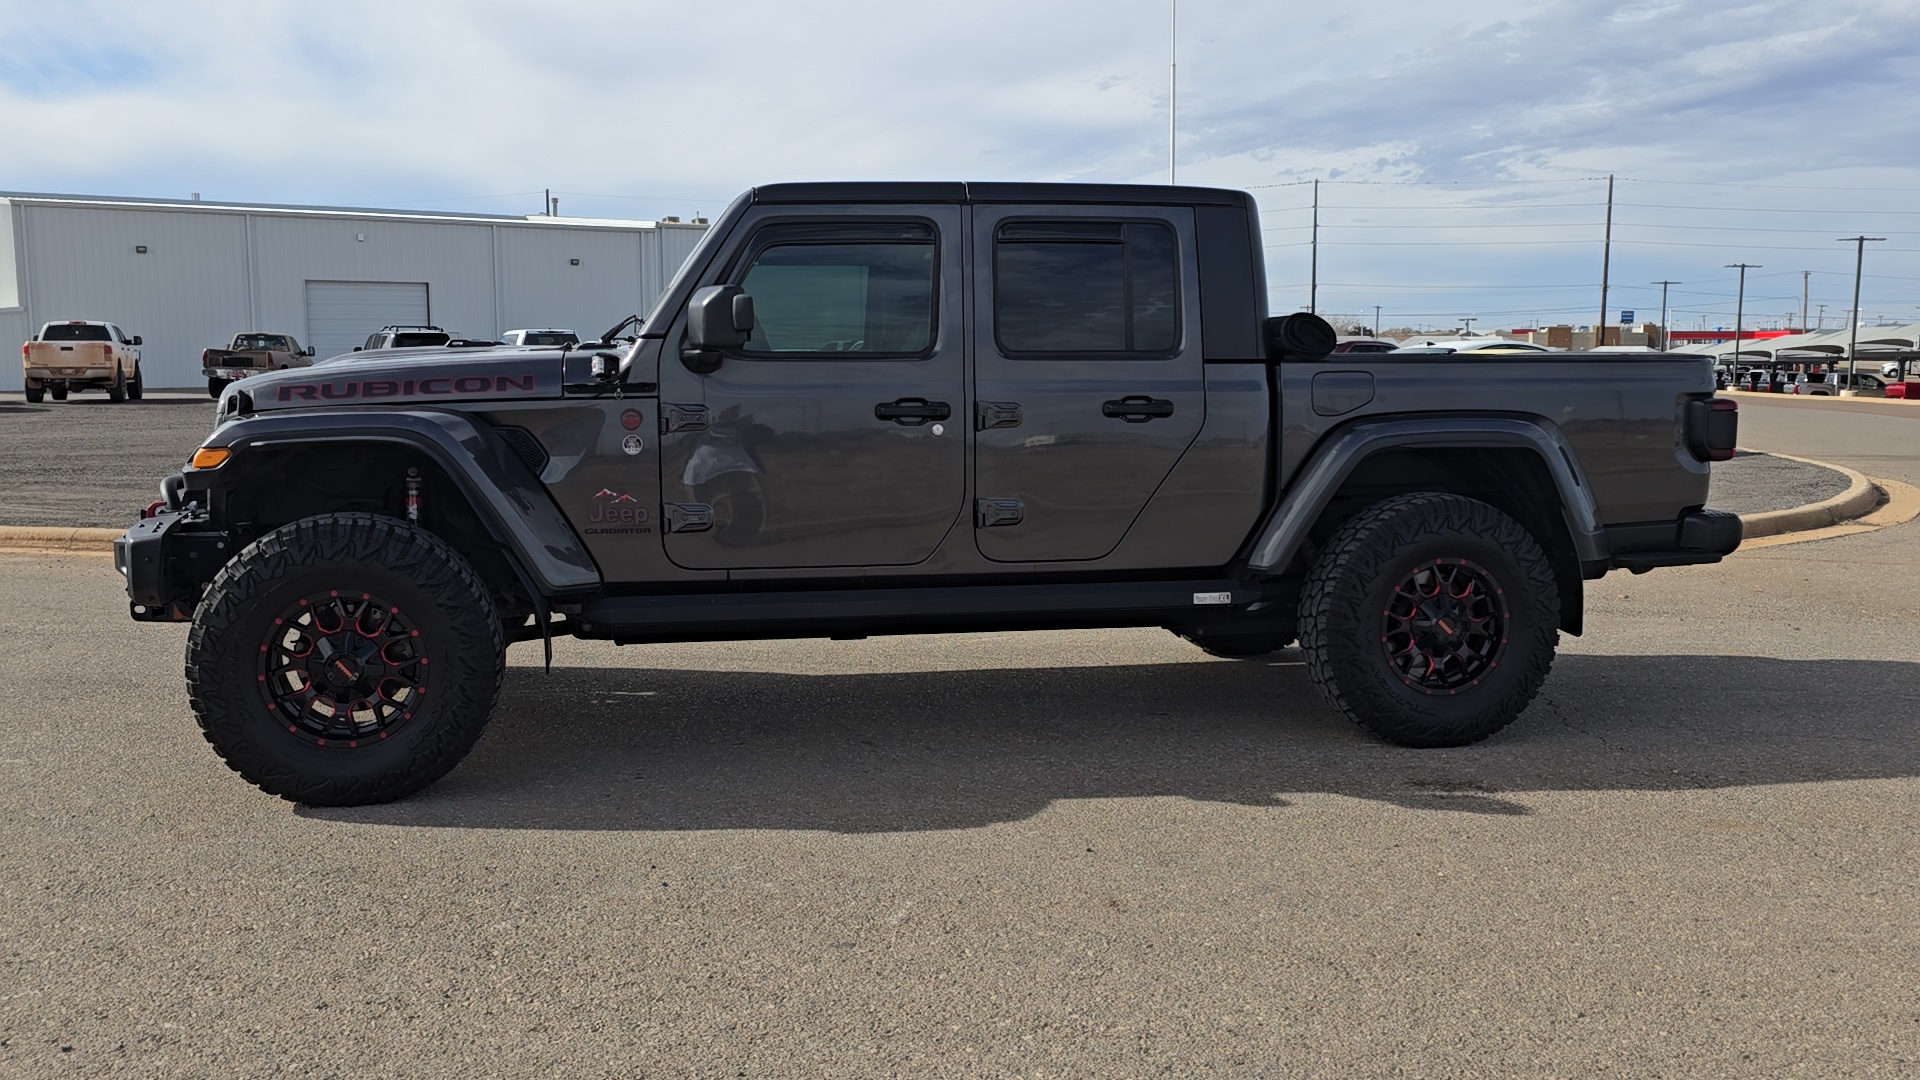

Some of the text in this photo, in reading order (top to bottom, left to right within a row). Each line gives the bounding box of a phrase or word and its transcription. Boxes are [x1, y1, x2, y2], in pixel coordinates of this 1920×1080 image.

[277, 374, 535, 401] RUBICON
[588, 503, 649, 526] Jeep
[584, 527, 652, 535] GLADIATOR
